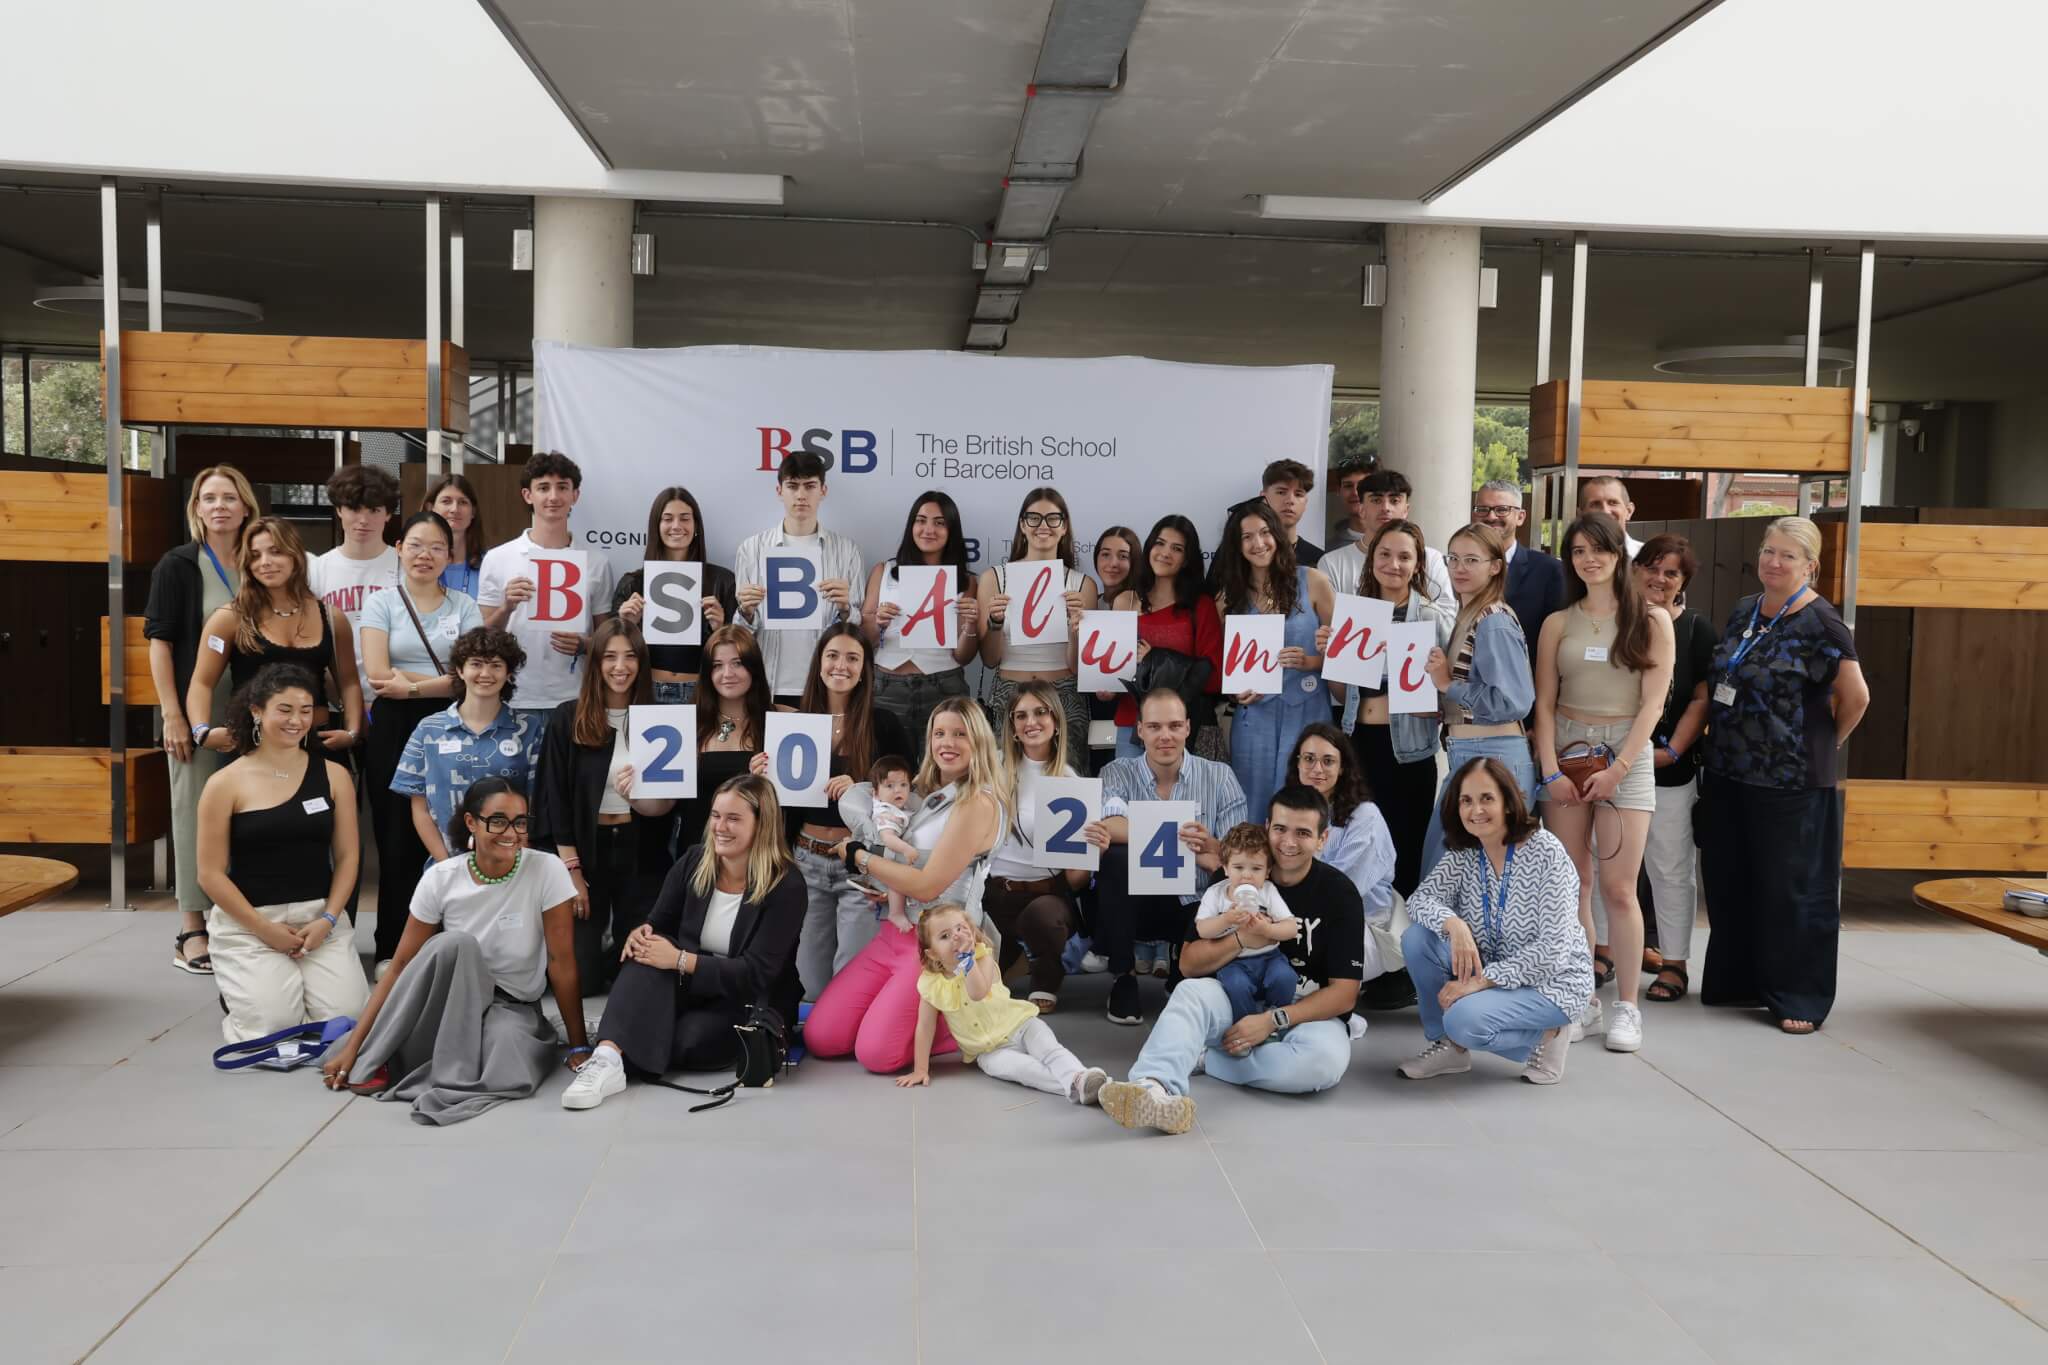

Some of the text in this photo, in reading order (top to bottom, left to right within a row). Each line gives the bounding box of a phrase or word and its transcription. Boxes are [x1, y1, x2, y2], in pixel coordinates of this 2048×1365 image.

[756, 426, 878, 474] BSB
[915, 433, 1117, 458] The British School
[915, 457, 1055, 481] of Barcelona
[529, 558, 584, 623] B
[649, 571, 697, 635] S
[766, 556, 818, 620] B
[641, 724, 1186, 880] 2 0 2 4
